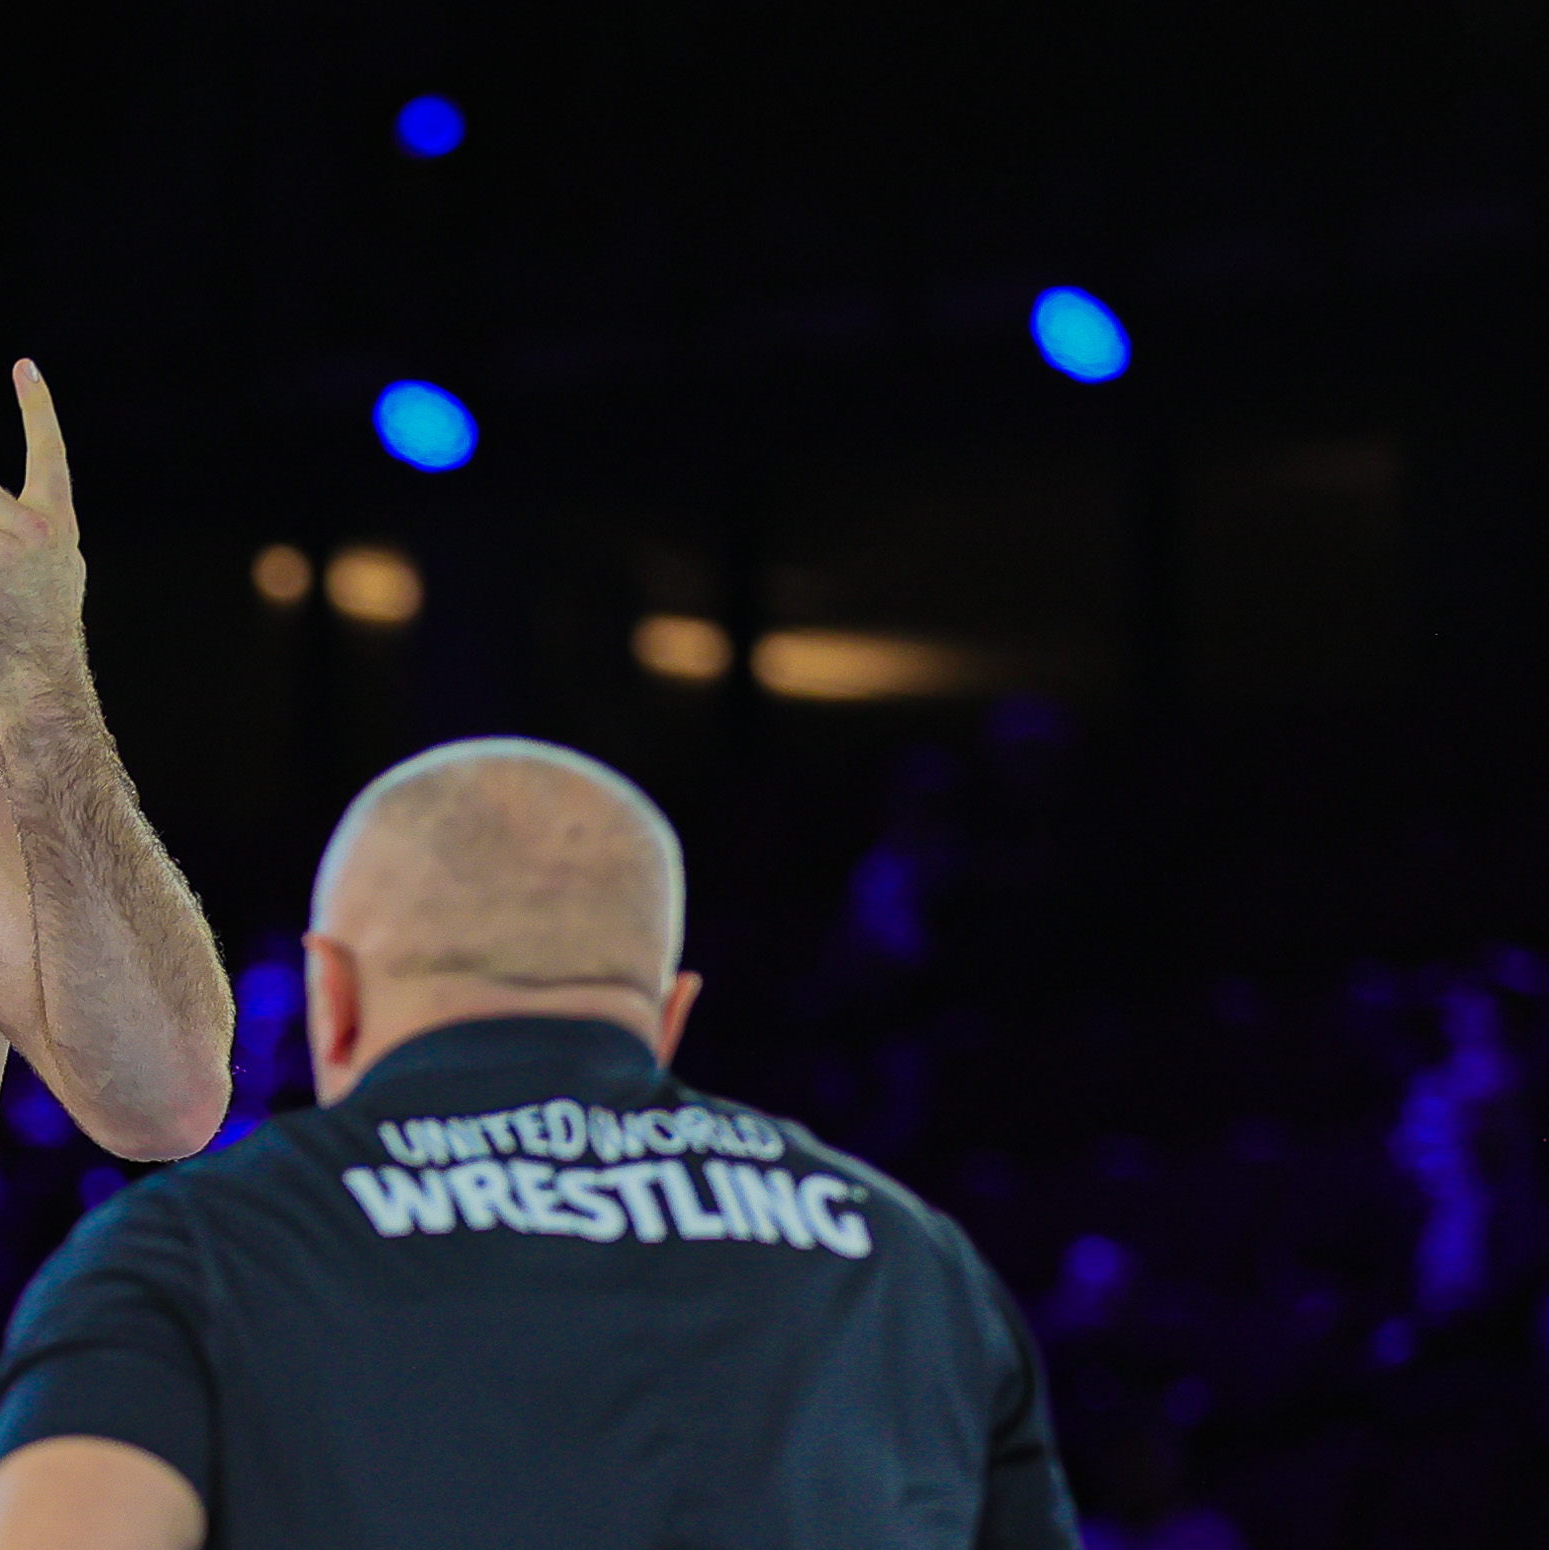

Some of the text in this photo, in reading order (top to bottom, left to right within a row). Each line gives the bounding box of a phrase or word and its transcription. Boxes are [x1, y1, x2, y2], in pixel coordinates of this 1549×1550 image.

[378, 1098, 786, 1167] UNITED WORLD
[341, 1157, 874, 1260] WRESTLING
